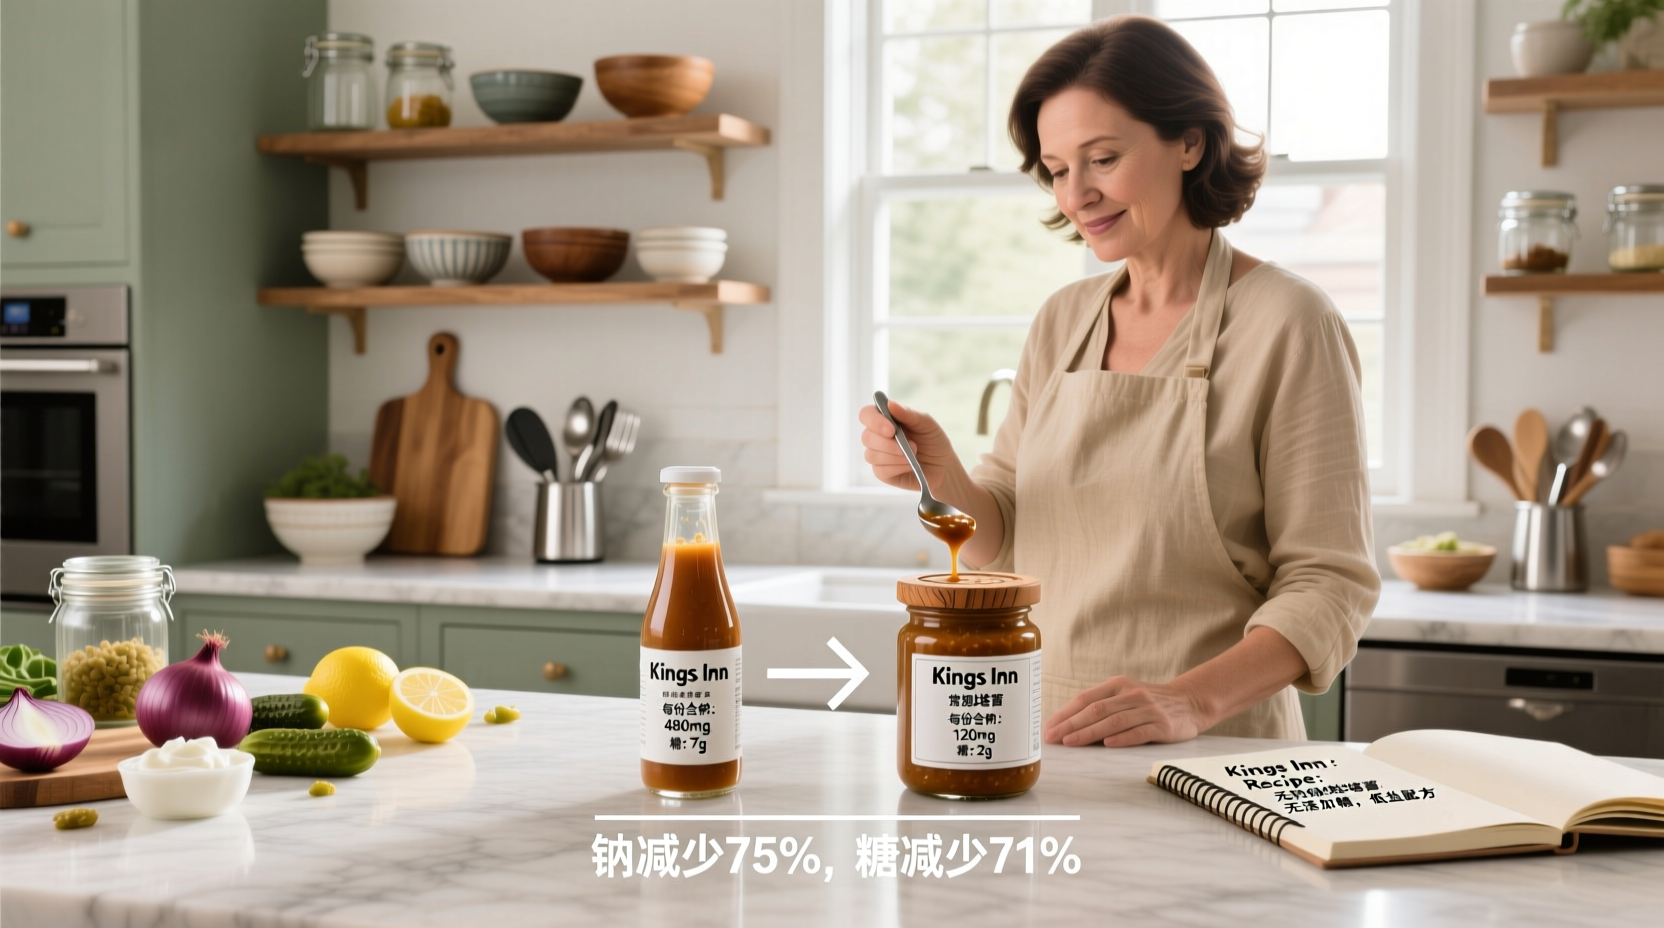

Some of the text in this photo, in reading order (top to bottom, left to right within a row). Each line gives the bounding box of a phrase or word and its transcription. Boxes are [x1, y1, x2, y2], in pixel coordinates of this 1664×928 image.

[651, 662, 728, 686] Kings Inn
[933, 667, 1018, 690] Kings Inn
[665, 719, 710, 735] 480mg
[954, 729, 995, 743] 120mg
[1225, 765, 1287, 778] Kings
[1243, 775, 1323, 790] Recipe:
